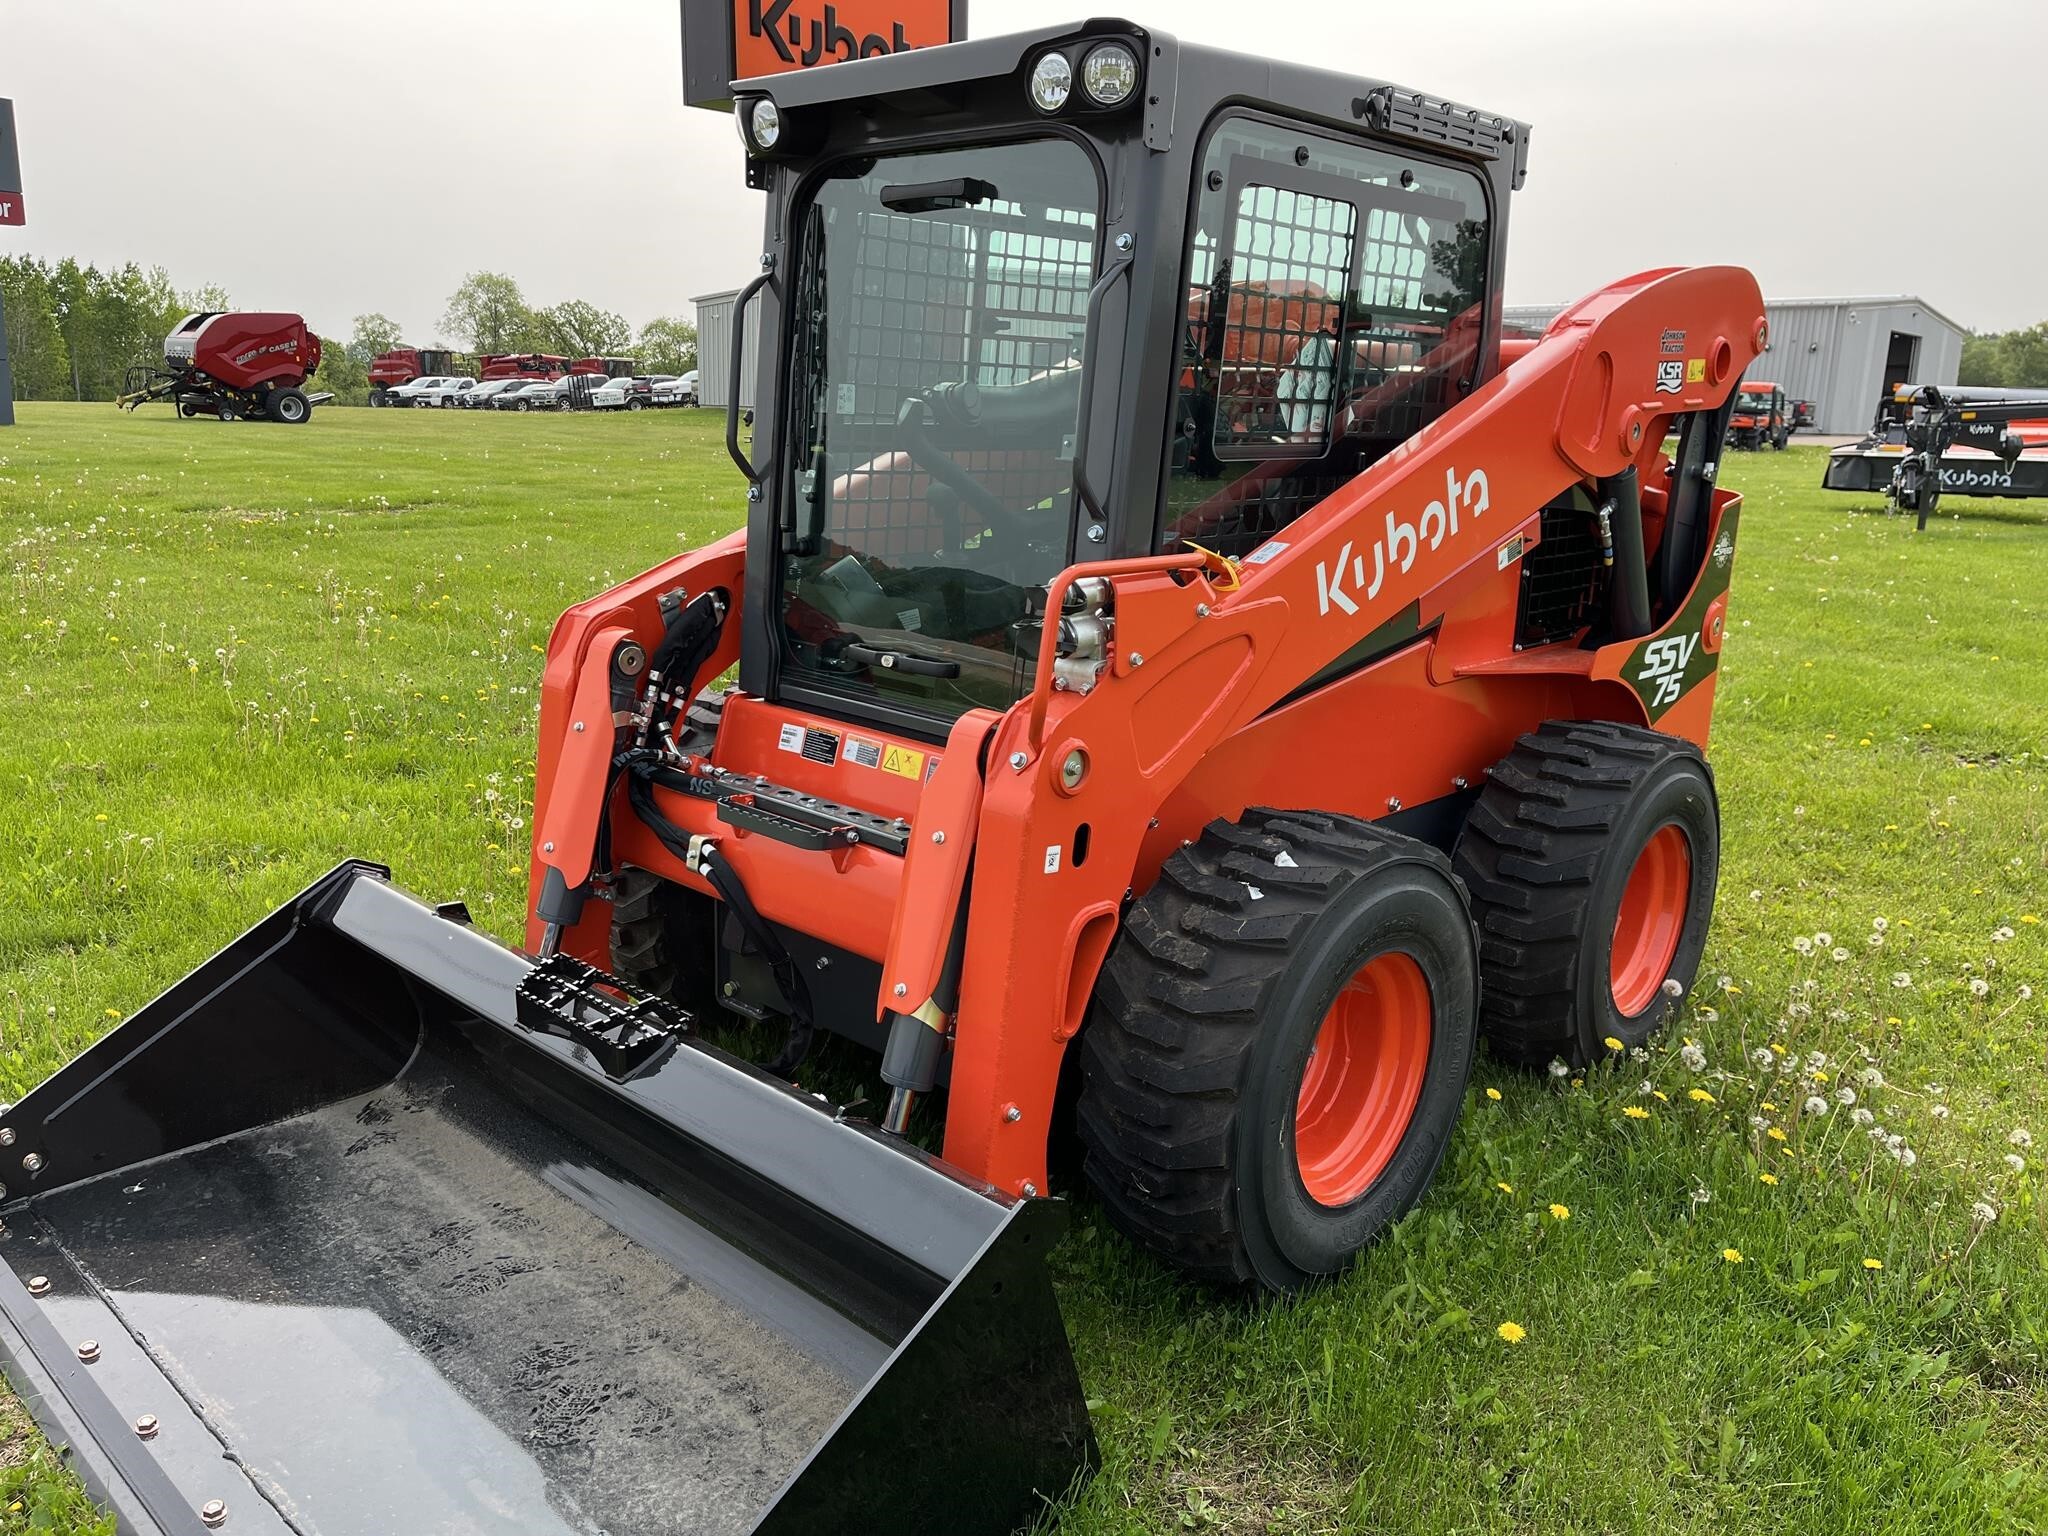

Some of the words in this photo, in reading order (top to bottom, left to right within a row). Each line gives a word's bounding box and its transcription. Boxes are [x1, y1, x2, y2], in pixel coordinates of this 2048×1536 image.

[749, 0, 931, 66] Kubot
[1657, 361, 1683, 380] KSR
[1969, 424, 1995, 435] Kubota
[1939, 468, 2012, 488] Kubota
[1316, 466, 1490, 616] Kubota
[1638, 631, 1700, 681] SSV
[1651, 671, 1684, 708] 75
